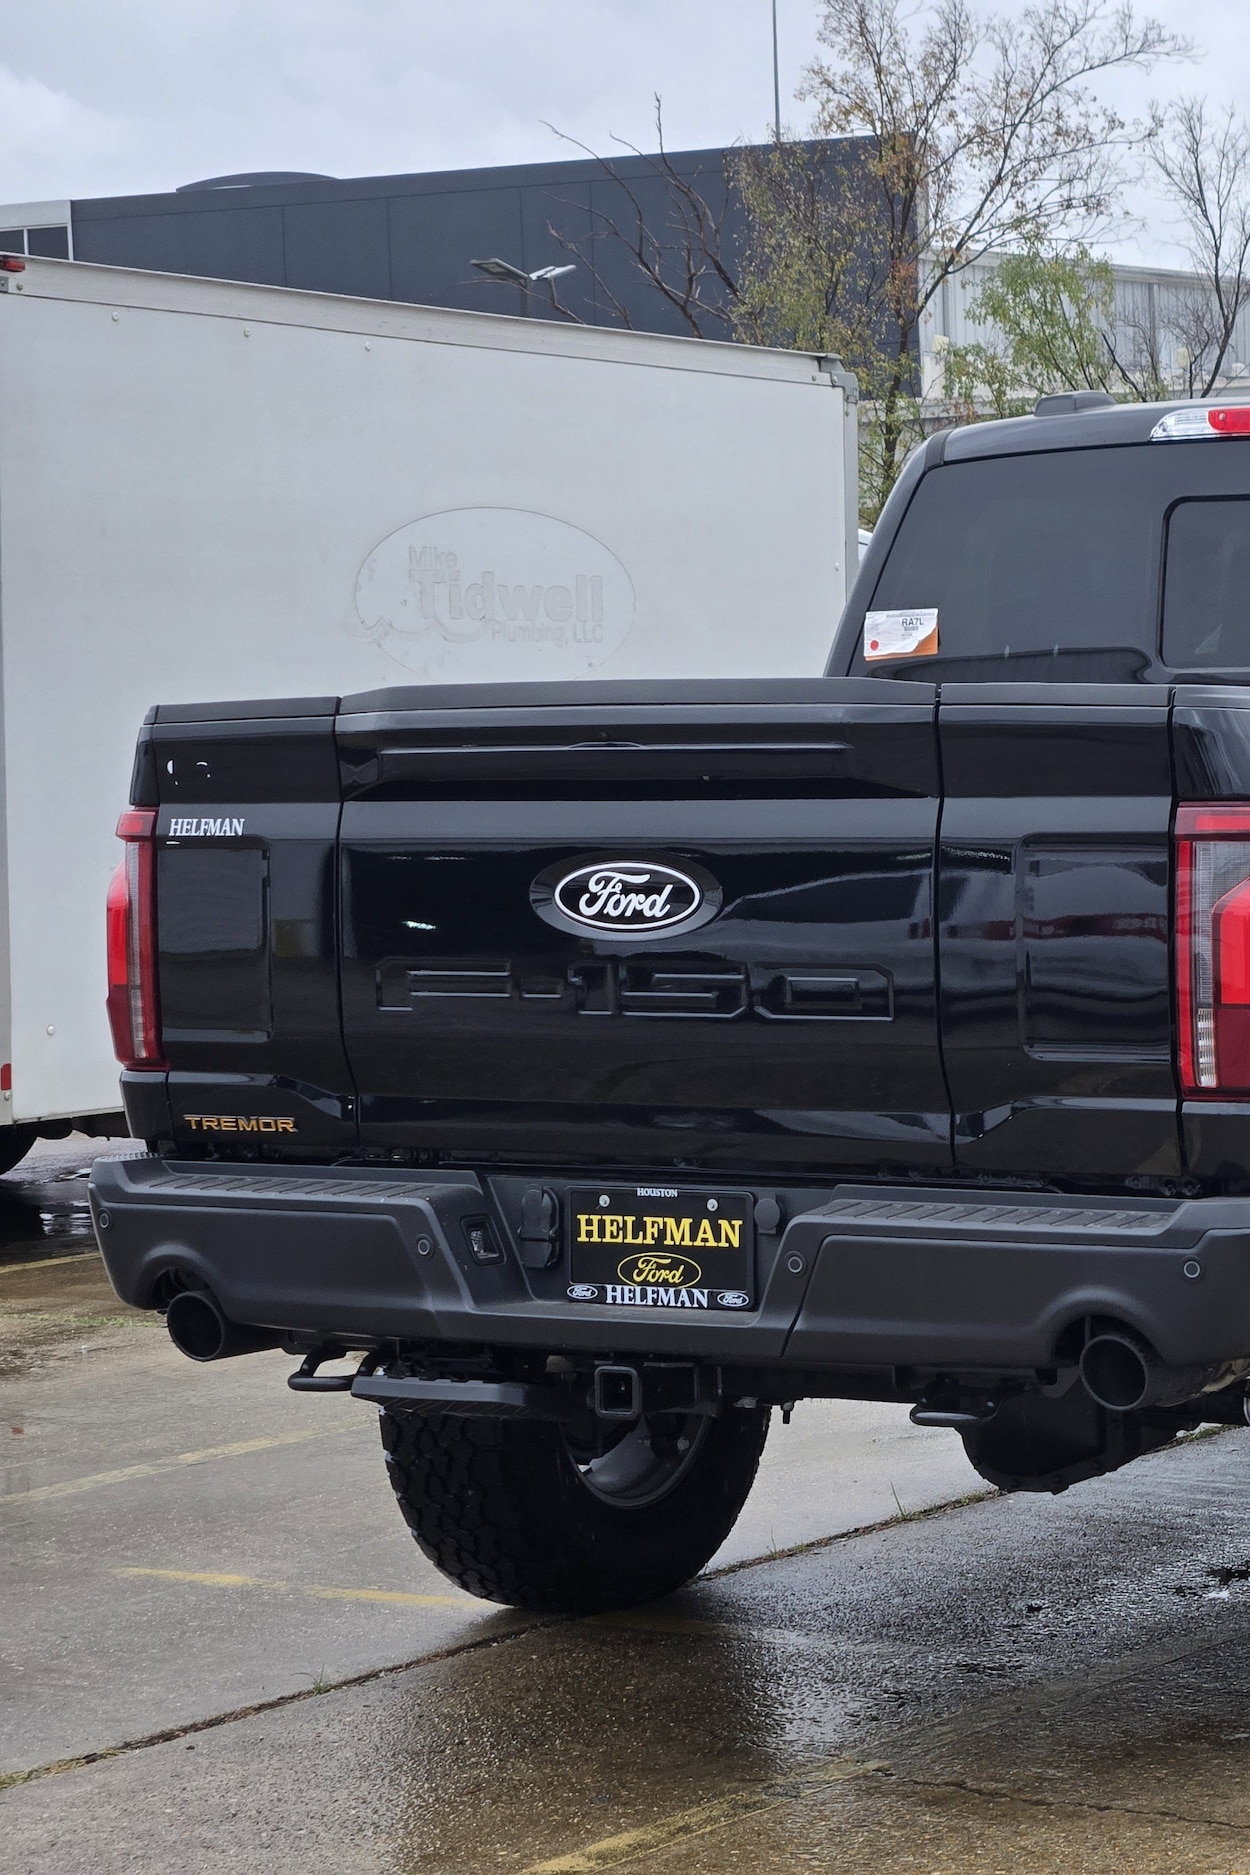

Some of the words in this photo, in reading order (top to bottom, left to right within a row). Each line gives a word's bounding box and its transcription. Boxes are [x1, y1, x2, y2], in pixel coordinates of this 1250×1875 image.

[408, 545, 459, 568] Mike
[408, 568, 604, 622] Tidwell
[573, 622, 604, 644] LLC
[169, 818, 246, 837] HELFMAN
[578, 870, 674, 919] Ford
[375, 956, 896, 1022] F-150
[183, 1114, 299, 1133] TREMOR
[636, 1187, 678, 1198] HOUSTON
[576, 1214, 743, 1248] HELFMAN
[632, 1256, 684, 1284] Ford
[605, 1284, 709, 1308] HELFMAN
